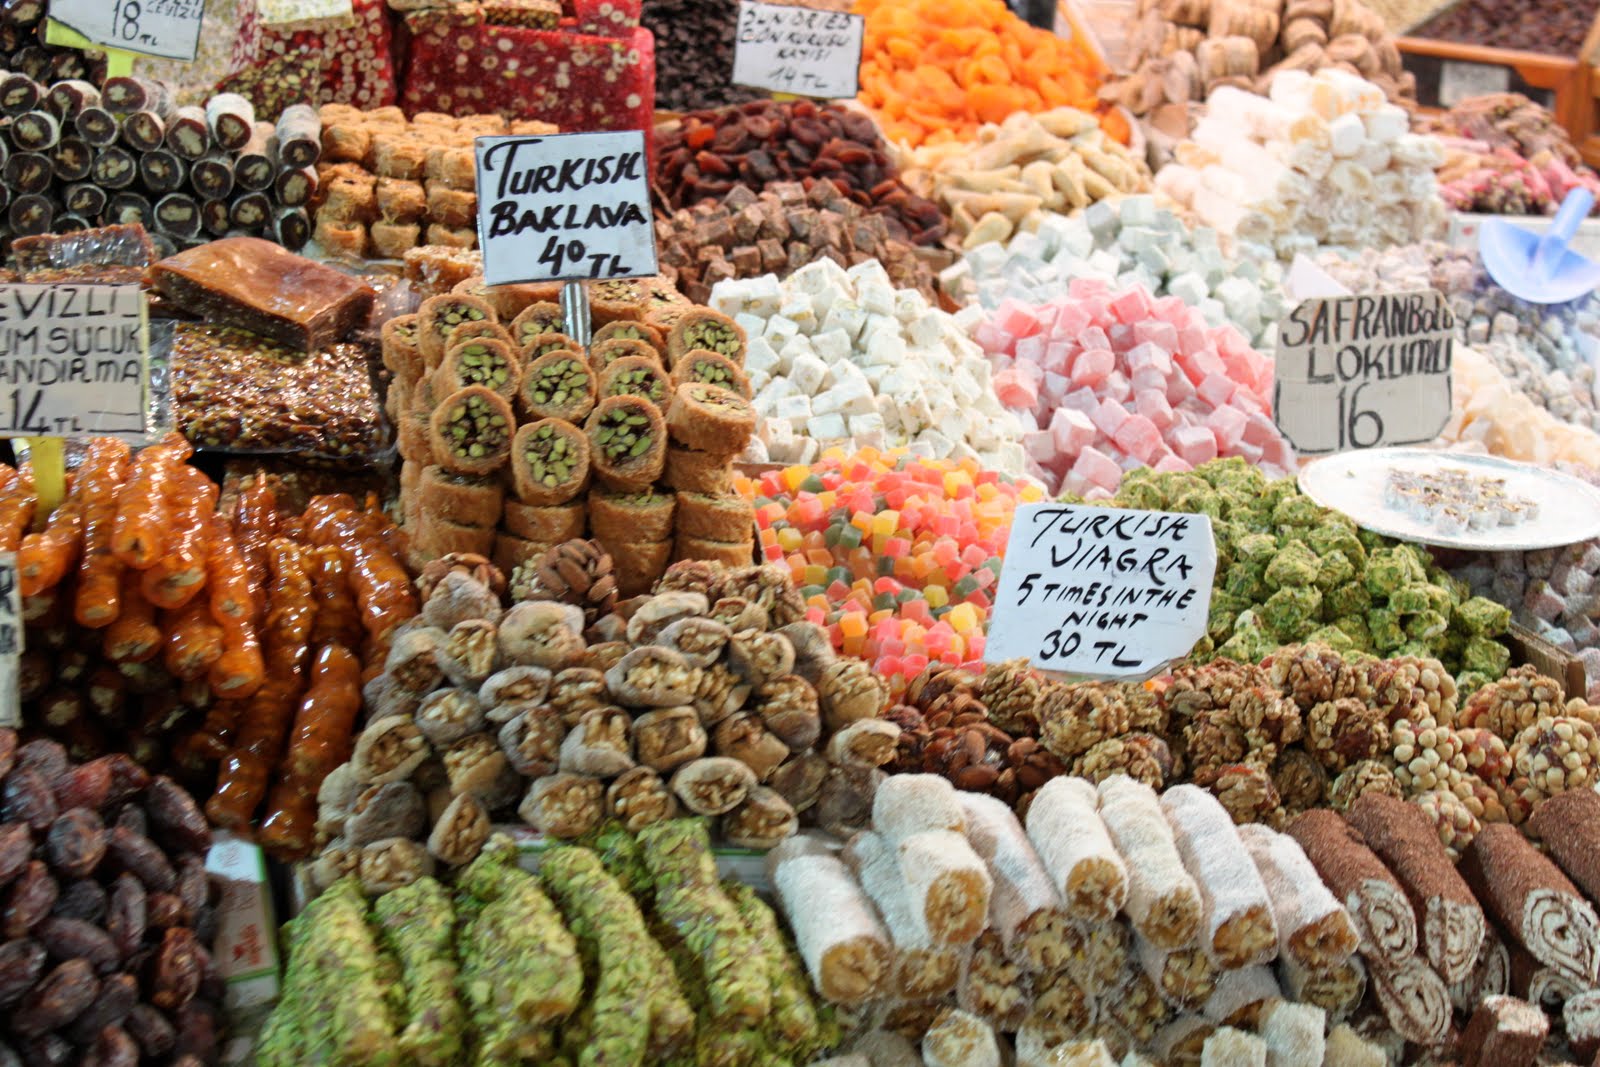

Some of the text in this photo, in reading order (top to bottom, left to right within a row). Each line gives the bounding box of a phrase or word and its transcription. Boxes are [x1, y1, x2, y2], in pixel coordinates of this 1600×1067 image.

[112, 0, 158, 46] 18 TL
[768, 67, 828, 88] 14 TL
[483, 139, 641, 199] TURKISH
[488, 201, 647, 239] BAKLAVA
[537, 236, 632, 278] 40 TL
[47, 324, 142, 356] SUCUK
[1307, 337, 1453, 384] LOKUMU
[10, 389, 83, 436] 14 TL
[1336, 382, 1384, 449] 16
[1031, 508, 1189, 548] TURKISH
[1051, 538, 1193, 586] VIAGRA
[1017, 573, 1042, 606] 5
[1043, 582, 1112, 608] TIMES
[1144, 588, 1196, 609] THE
[1062, 611, 1148, 630] NIGHT
[1040, 629, 1143, 667] 30 TL
